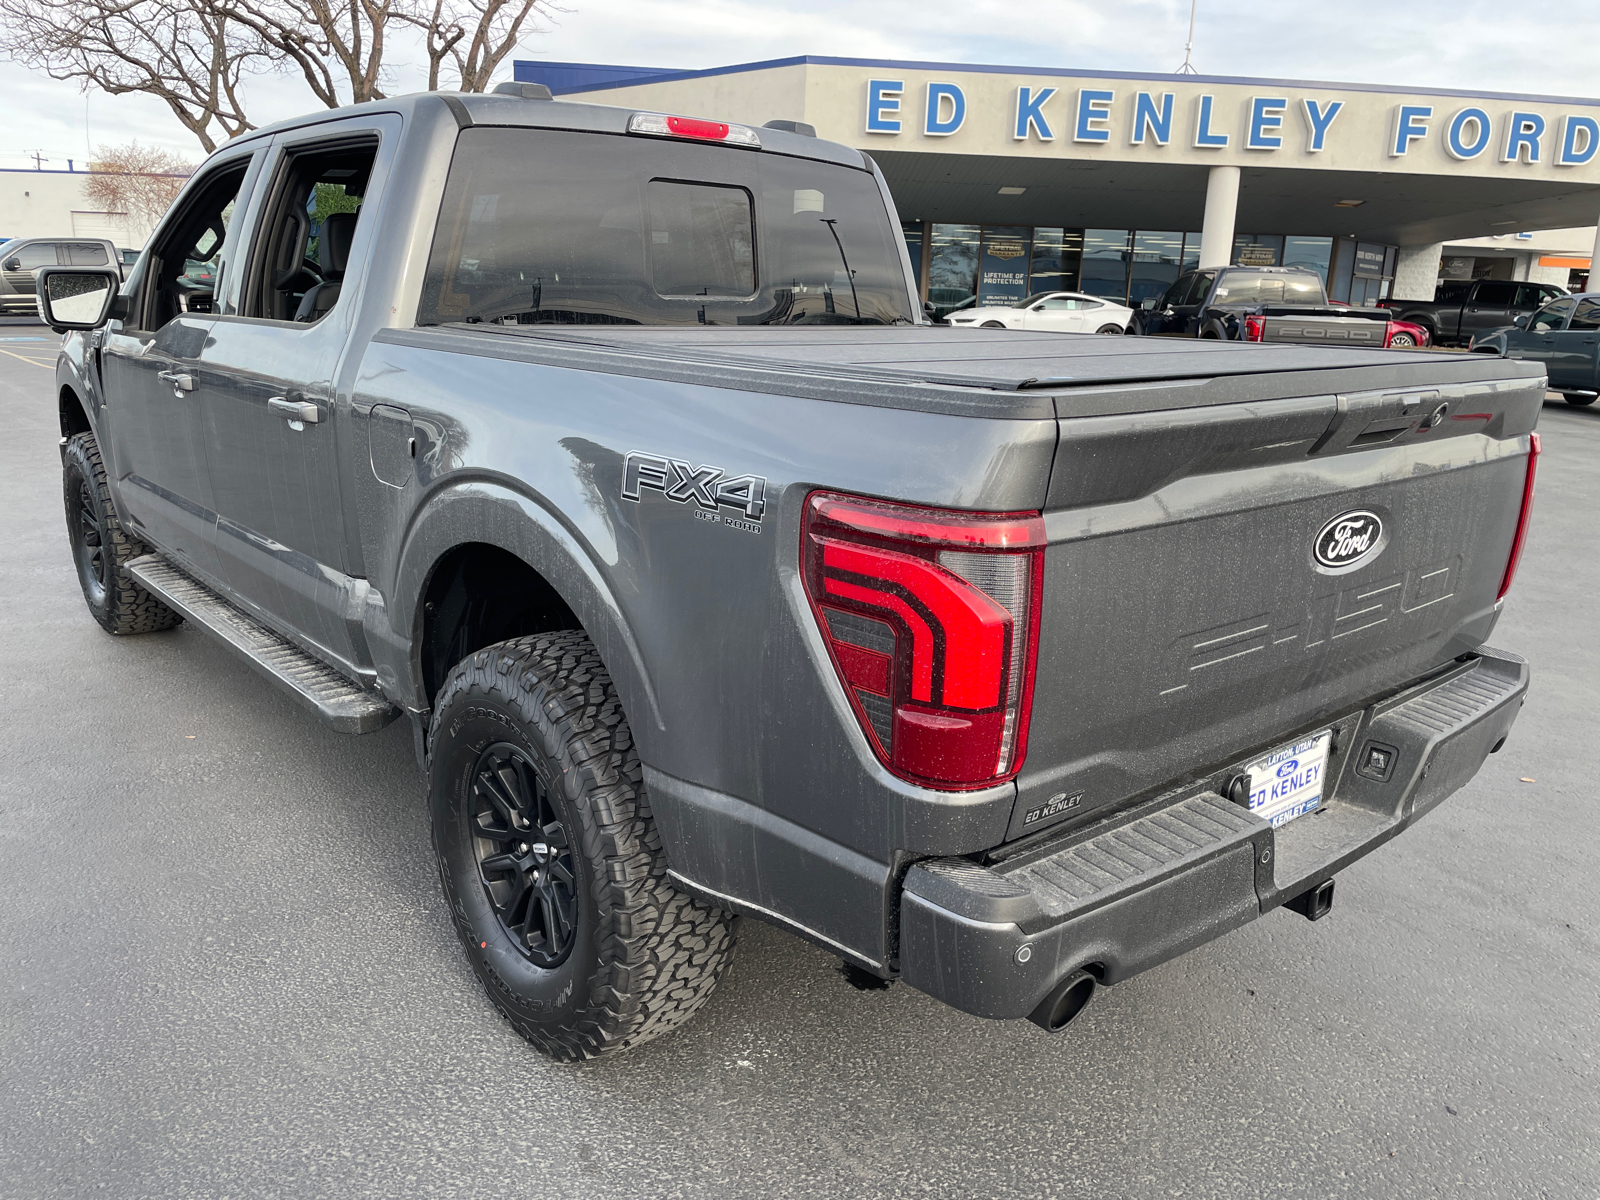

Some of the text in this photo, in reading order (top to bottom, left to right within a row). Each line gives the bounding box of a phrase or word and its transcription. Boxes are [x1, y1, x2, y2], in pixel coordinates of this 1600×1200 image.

[865, 78, 1600, 167] ED KENLEY FORD
[1279, 327, 1372, 339] FORD
[621, 449, 767, 523] FX4
[694, 509, 762, 535] OFF ROAD
[1327, 519, 1374, 559] Ford
[1249, 788, 1266, 811] ED
[1271, 763, 1322, 801] KENLEY
[1025, 794, 1083, 824] ED KENLEY
